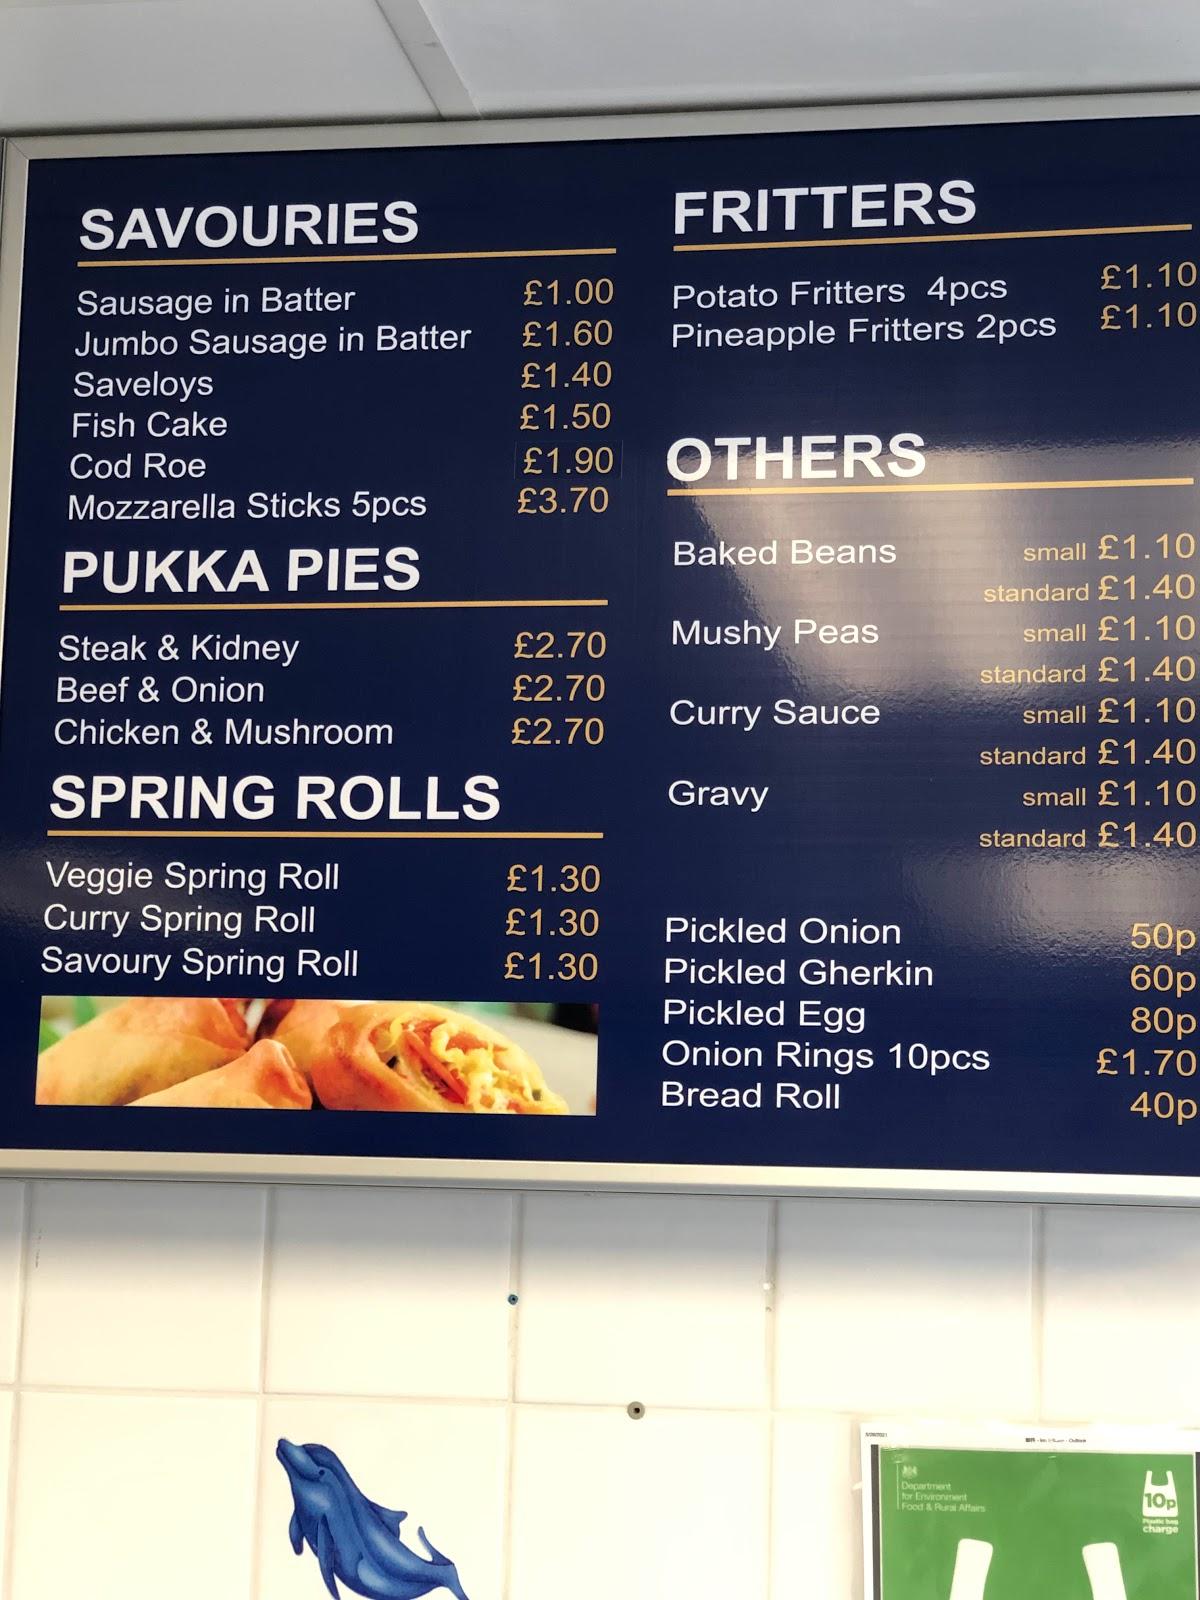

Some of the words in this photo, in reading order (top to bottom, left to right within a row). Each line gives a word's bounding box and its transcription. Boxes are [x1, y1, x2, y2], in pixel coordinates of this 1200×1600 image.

[674, 179, 977, 234] FRITTERS
[79, 200, 419, 251] SAVOURIES
[1100, 261, 1198, 291] £1.10
[76, 289, 213, 321] Sausage
[223, 288, 250, 314] in
[261, 286, 355, 312] Batter
[523, 278, 614, 307] £1.00
[673, 282, 778, 309] Potato
[790, 278, 906, 306] Fritters
[926, 275, 1008, 307] 4pcs
[1100, 301, 1198, 331] £1.10
[74, 330, 179, 357] Jumbo
[189, 328, 328, 360] Sausage
[338, 325, 365, 353] in
[376, 324, 471, 351] Batter
[522, 319, 613, 348] £1.60
[672, 320, 836, 352] Pineapple
[849, 316, 965, 344] Fritters
[976, 313, 1057, 344] 2pcs
[73, 370, 214, 402] Saveloys
[521, 361, 613, 390] £1.40
[72, 412, 135, 439] Fish
[146, 411, 228, 438] Cake
[519, 403, 611, 431] £1.50
[69, 453, 132, 480] Cod
[144, 453, 207, 479] Roe
[523, 446, 614, 475] £1.90
[666, 432, 926, 482] OTHERS
[68, 494, 236, 521] Mozzarella
[246, 492, 341, 519] Sticks
[351, 491, 427, 523] 5pcs
[517, 486, 609, 514] £3.70
[674, 540, 778, 567] Baked
[790, 539, 897, 564] Beans
[1023, 541, 1087, 561] small
[1098, 533, 1196, 561] £1.10
[63, 548, 269, 593] PUKKA
[288, 546, 420, 592] PIES
[983, 582, 1089, 602] standard
[1098, 574, 1196, 602] £1.40
[671, 619, 781, 651] Mushy
[793, 618, 880, 644] Peas
[1023, 623, 1087, 643] small
[1098, 615, 1196, 643] £1.10
[58, 635, 147, 661] Steak
[158, 635, 179, 661] &
[192, 634, 300, 666] Kidney
[513, 631, 607, 659] £2.70
[980, 664, 1087, 684] standard
[1098, 656, 1196, 683] £1.40
[56, 676, 128, 704] Beef
[138, 677, 160, 703] &
[171, 676, 265, 703] Onion
[512, 674, 605, 703] £2.70
[669, 700, 761, 731] Curry
[772, 699, 881, 726] Sauce
[1023, 704, 1087, 724] small
[1098, 697, 1196, 724] £1.10
[54, 718, 179, 746] Chicken
[191, 719, 213, 745] &
[225, 718, 393, 745] Mushroom
[512, 717, 604, 746] £2.70
[979, 746, 1087, 766] standard
[1098, 738, 1196, 765] £1.40
[50, 775, 274, 820] SPRING
[297, 775, 500, 821] ROLLS
[668, 781, 769, 812] Gravy
[1022, 787, 1087, 807] small
[1098, 779, 1196, 807] £1.10
[979, 829, 1087, 848] standard
[1098, 821, 1197, 849] £1.40
[46, 861, 153, 895] Veggie
[164, 862, 267, 896] Spring
[279, 862, 340, 890] Roll
[507, 864, 601, 893] £1.30
[43, 903, 129, 937] Curry
[139, 904, 242, 939] Spring
[255, 905, 315, 933] Roll
[505, 907, 600, 937] £1.30
[665, 917, 786, 945] Pickled
[799, 918, 901, 945] Onion
[1130, 922, 1196, 954] 50p
[40, 946, 171, 980] Savoury
[181, 948, 285, 982] Spring
[297, 949, 359, 977] Roll
[504, 951, 599, 981] £1.30
[664, 958, 786, 985] Pickled
[799, 959, 934, 987] Gherkin
[1130, 964, 1196, 997] 60p
[663, 998, 785, 1027] Pickled
[798, 1000, 866, 1034] Egg
[1130, 1006, 1197, 1039] 80p
[661, 1040, 763, 1067] Onion
[776, 1041, 874, 1074] Rings
[888, 1043, 991, 1076] 10pcs
[1096, 1048, 1197, 1076] £1.70
[661, 1081, 763, 1108] Bread
[775, 1082, 840, 1110] Roll
[1130, 1091, 1198, 1125] 40p
[901, 1481, 952, 1491] Department
[901, 1491, 913, 1501] for
[915, 1491, 967, 1502] Environment
[901, 1502, 924, 1511] Food
[926, 1503, 933, 1511] &
[935, 1503, 957, 1512] Rural
[959, 1503, 986, 1513] Affairs
[1144, 1492, 1177, 1511] 10p
[1142, 1525, 1179, 1535] charge
